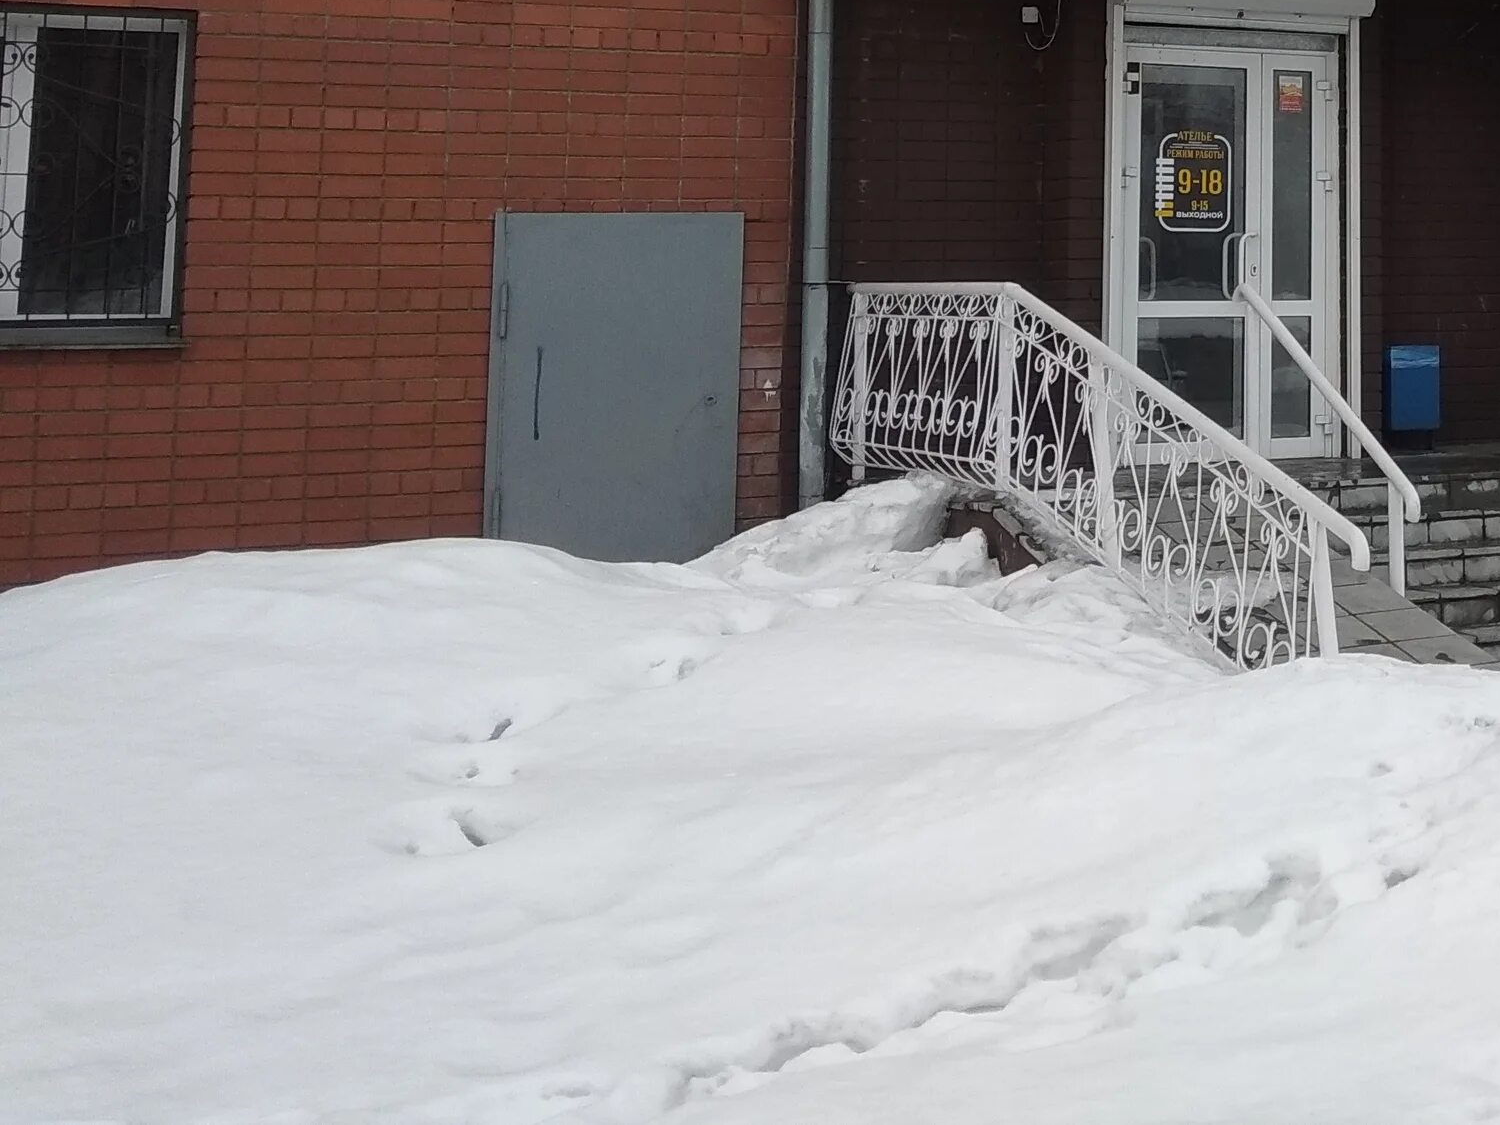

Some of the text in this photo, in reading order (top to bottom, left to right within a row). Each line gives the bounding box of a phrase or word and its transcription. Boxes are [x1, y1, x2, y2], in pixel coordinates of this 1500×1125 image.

[1177, 130, 1213, 142] АТЕЛЬЕ
[1166, 149, 1225, 160] РЕЖИМ РАБОТЫ
[1178, 168, 1222, 194] 9-18
